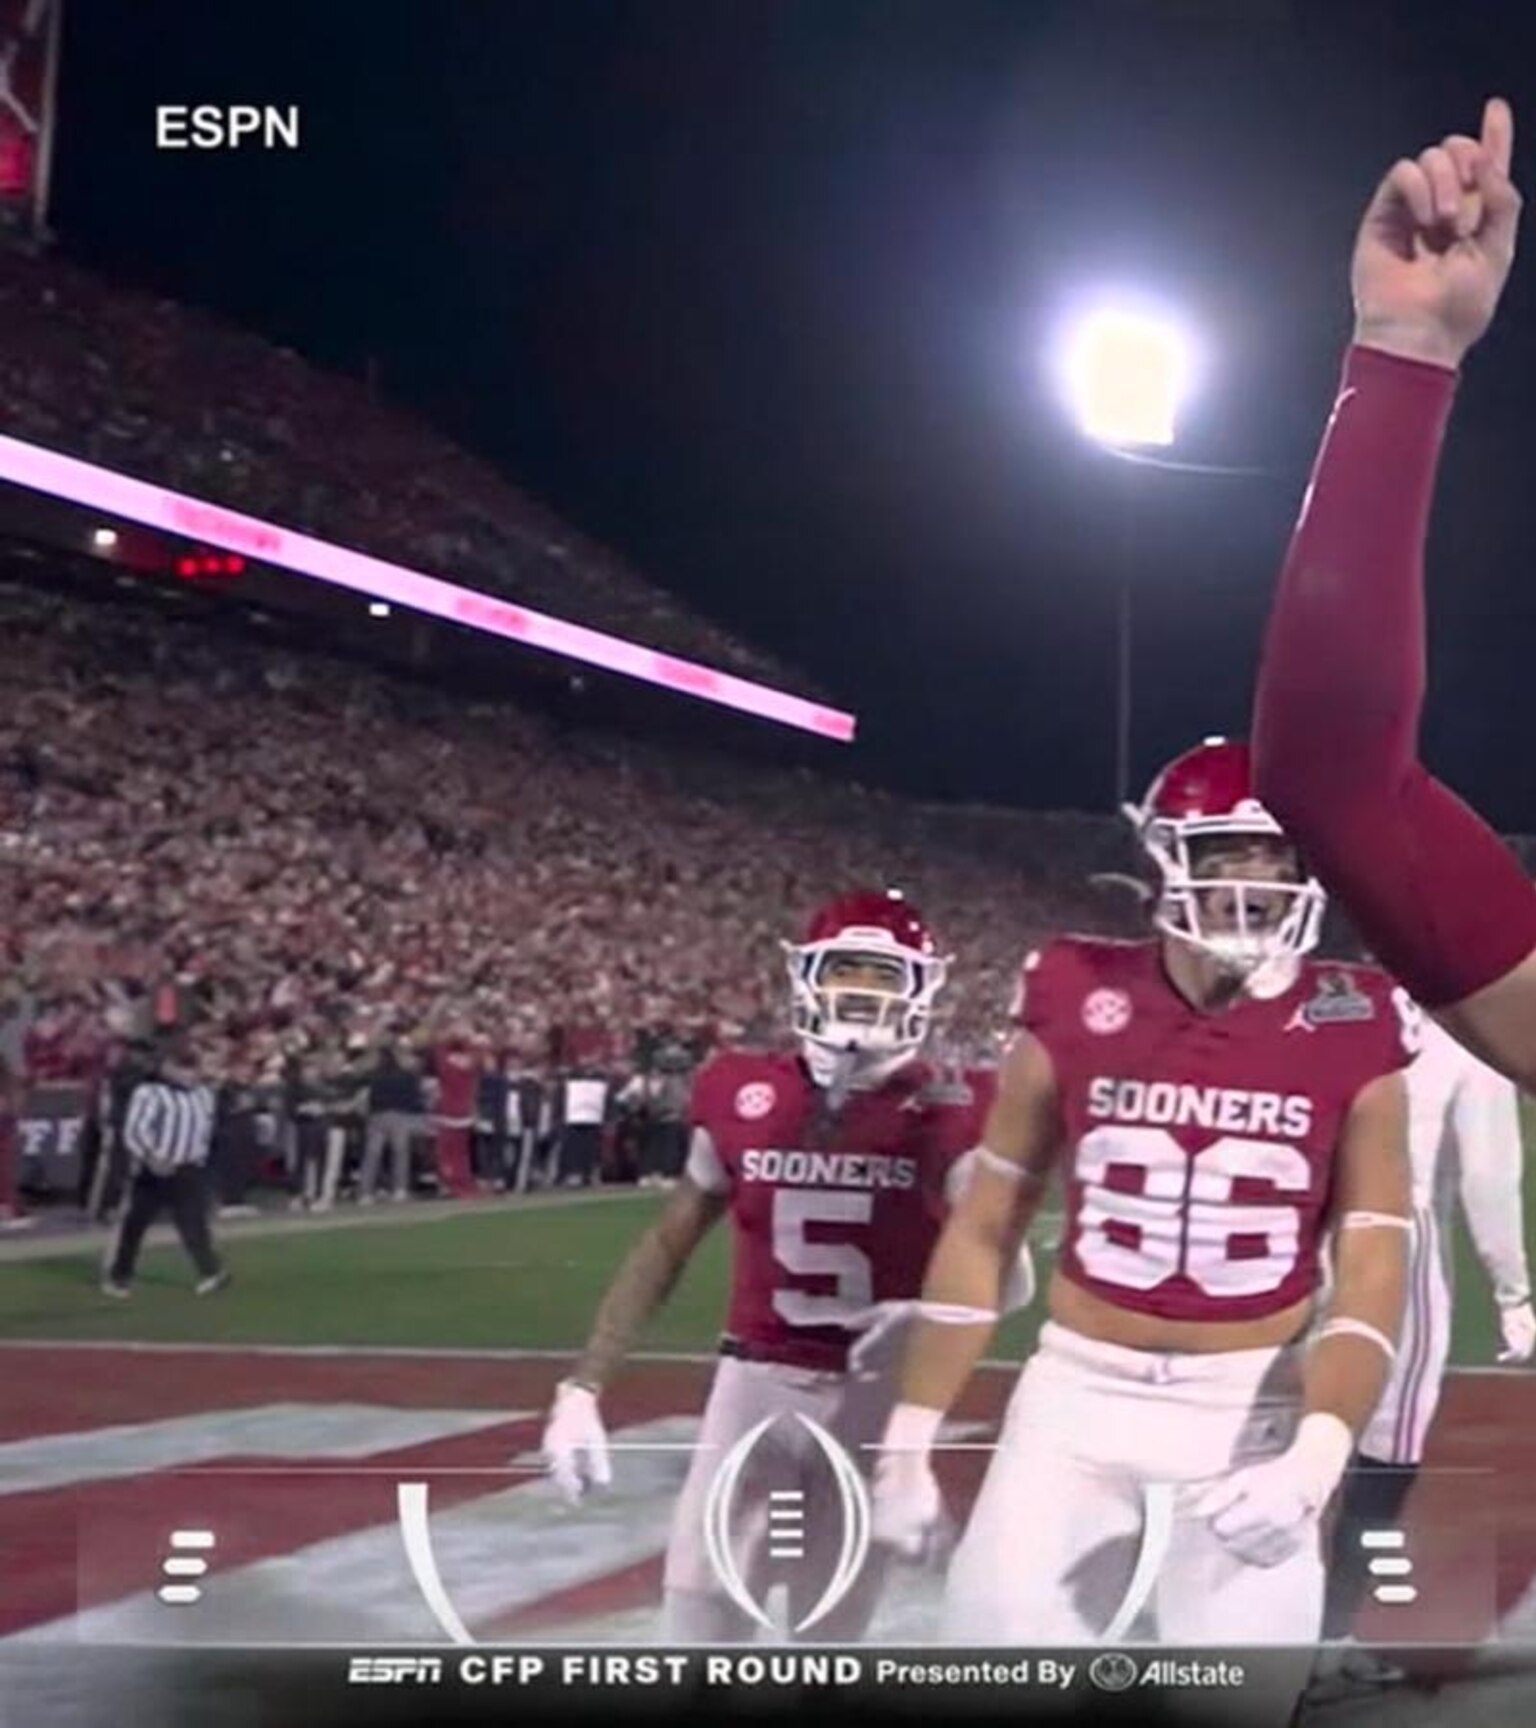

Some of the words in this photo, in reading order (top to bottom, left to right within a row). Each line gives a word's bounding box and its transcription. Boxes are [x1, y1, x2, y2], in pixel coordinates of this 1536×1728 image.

[1088, 1077, 1313, 1138] SOONERS
[741, 1149, 917, 1188] SOONERS
[1074, 1125, 1311, 1297] 86
[771, 1187, 874, 1329] 5
